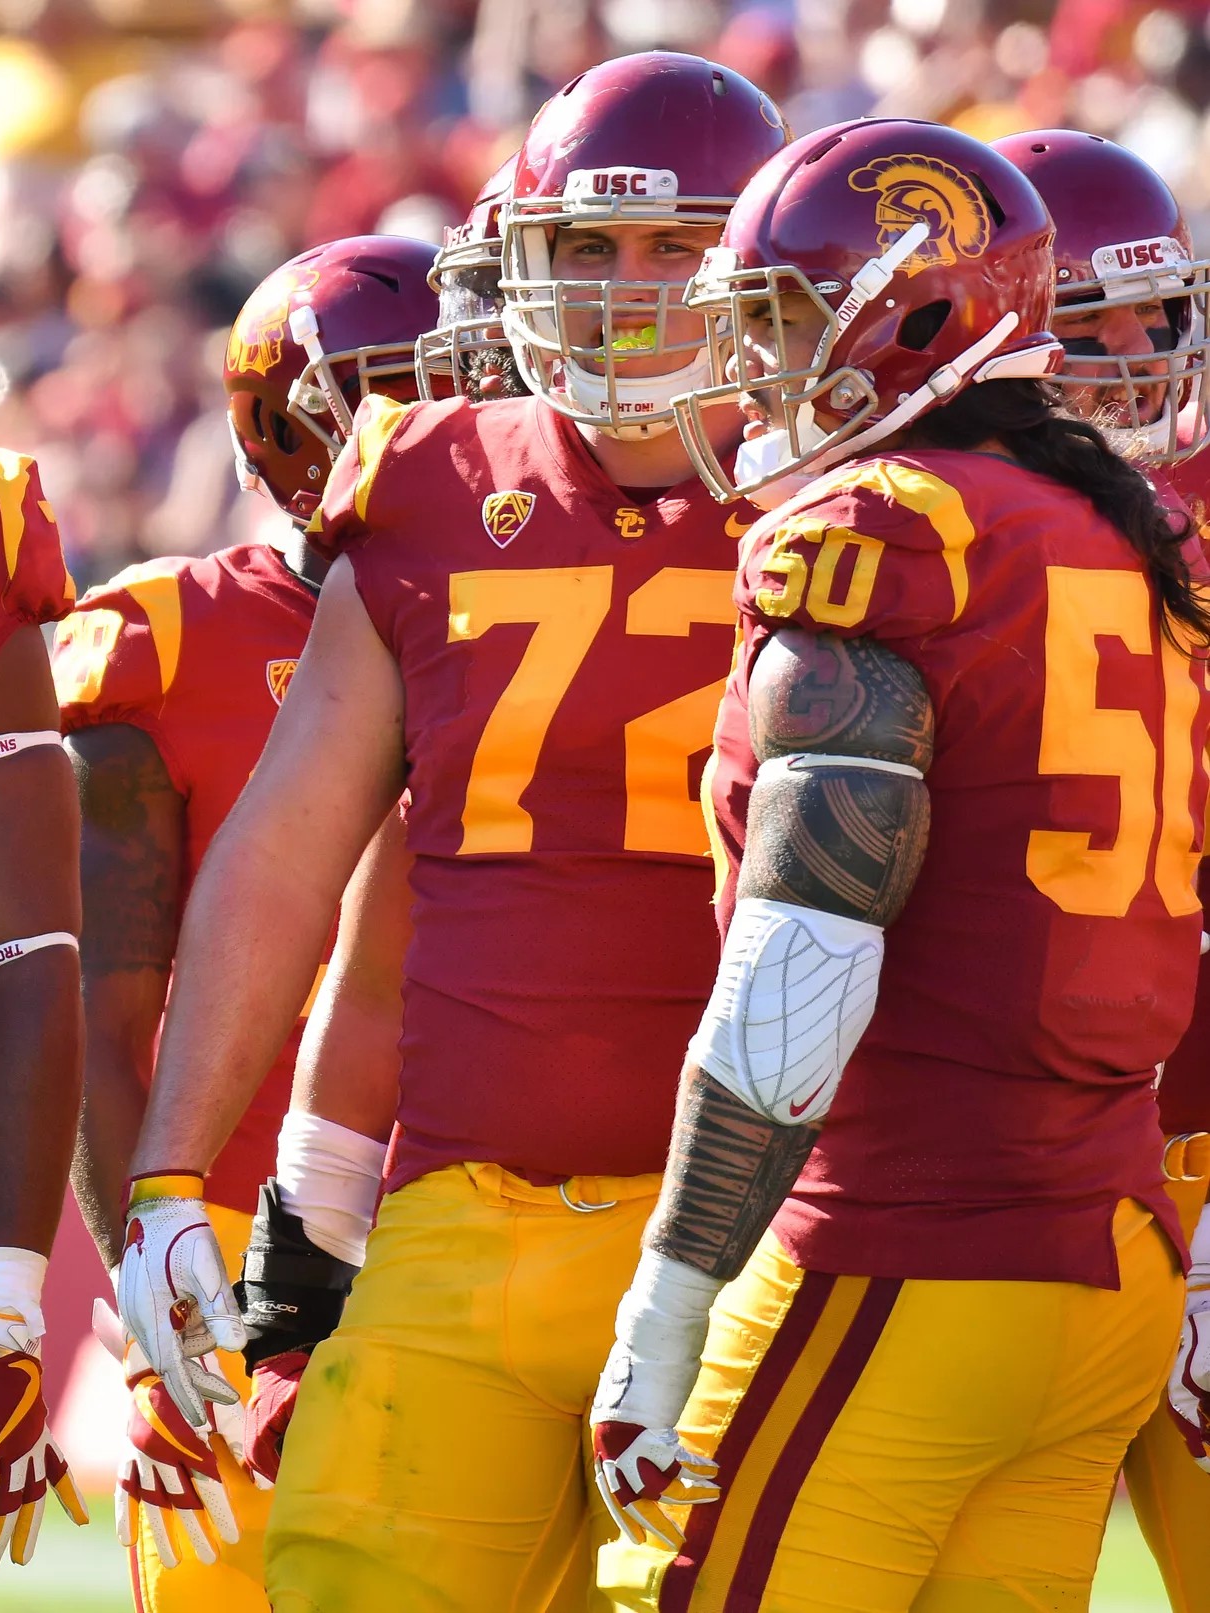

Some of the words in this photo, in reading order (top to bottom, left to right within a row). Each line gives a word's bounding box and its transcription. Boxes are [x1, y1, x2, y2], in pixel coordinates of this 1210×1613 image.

[592, 173, 647, 195] USC
[1115, 242, 1164, 269] USC
[838, 297, 862, 322] ON!
[600, 401, 632, 412] FIHT
[634, 402, 654, 412] ON!
[484, 492, 531, 524] PAC
[492, 513, 517, 535] 12
[756, 516, 886, 628] 50
[270, 660, 298, 694] PA
[446, 564, 739, 858] 72
